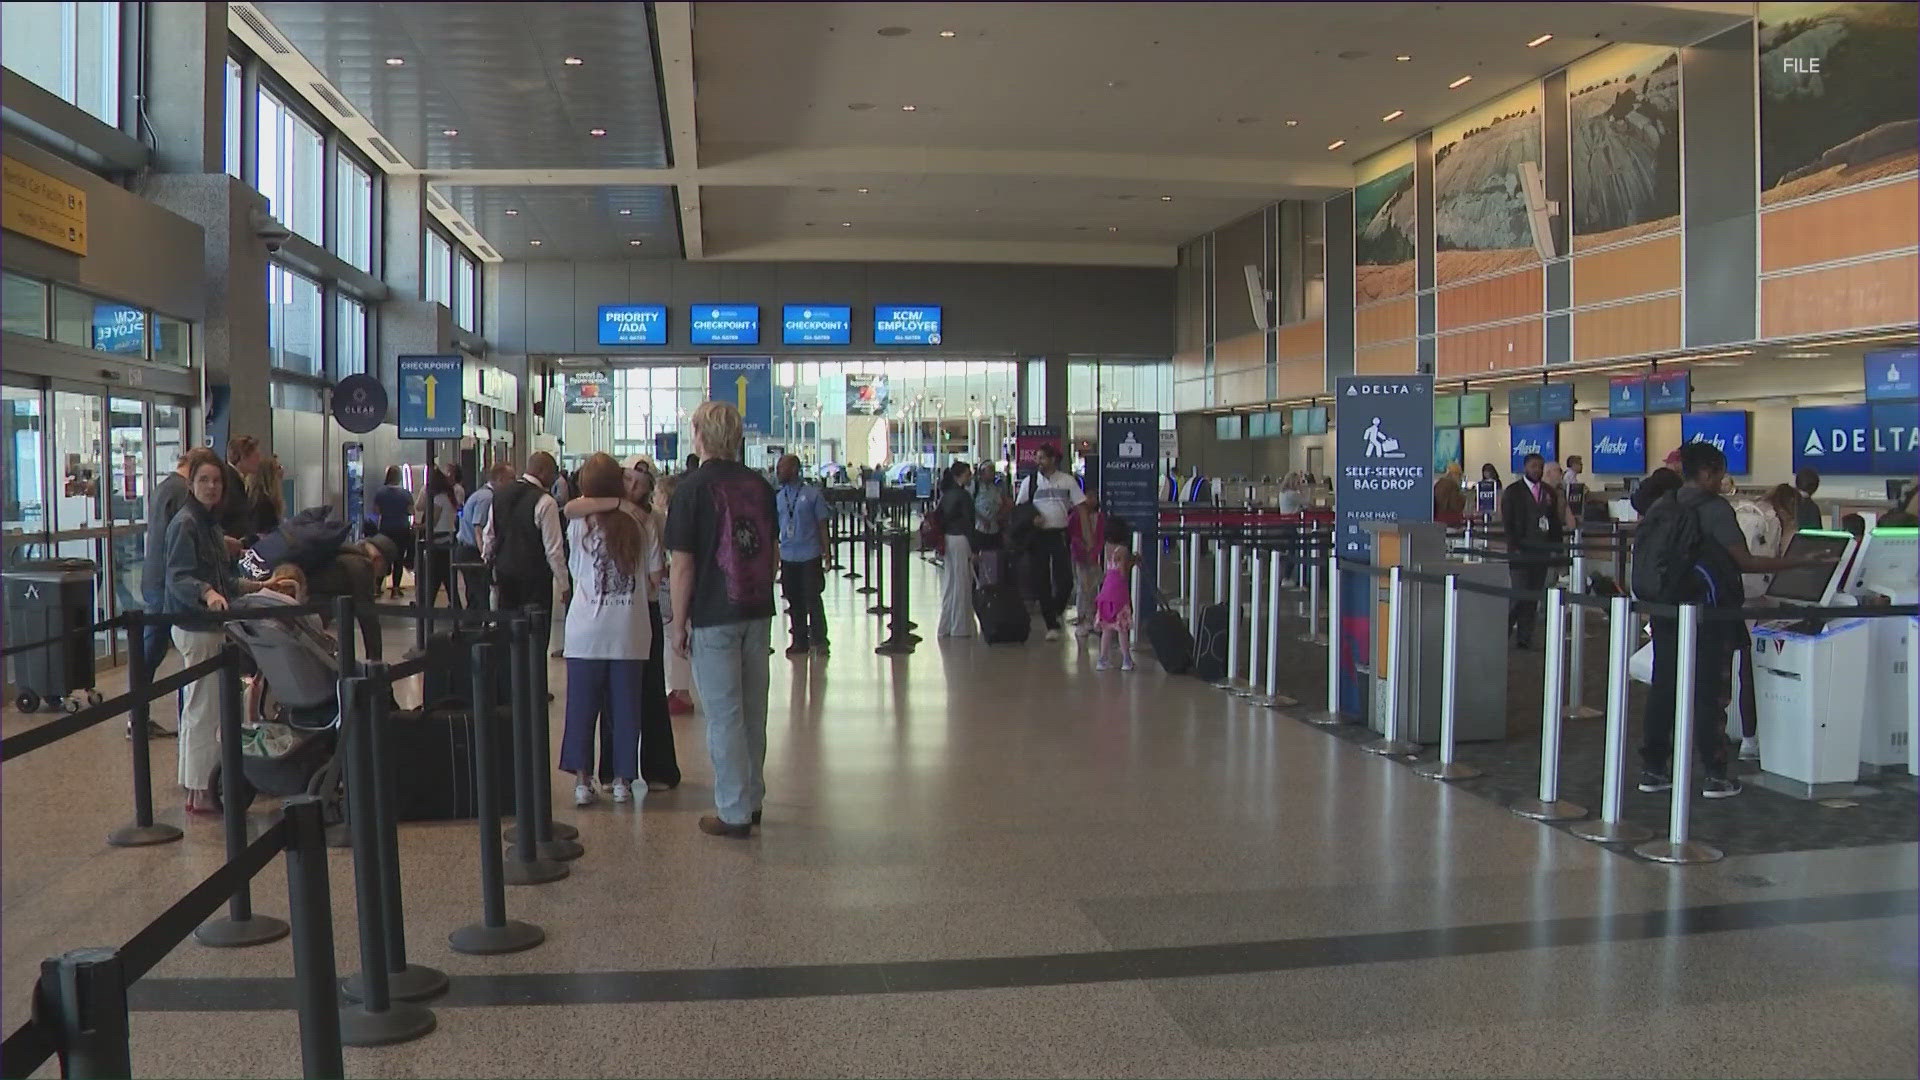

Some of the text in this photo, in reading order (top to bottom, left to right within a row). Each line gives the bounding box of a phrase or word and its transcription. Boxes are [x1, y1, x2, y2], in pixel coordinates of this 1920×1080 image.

[605, 311, 659, 323] PRIORITY
[893, 310, 923, 321] KCM/
[618, 323, 647, 332] /ADA
[693, 321, 757, 331] CHECKPOINT 1
[785, 321, 849, 331] CHECKPOINT 1
[877, 321, 938, 332] EMPLOYEE
[401, 362, 461, 370] CHECKPOINT 1
[712, 363, 765, 371] CHECKPOINT
[1361, 384, 1409, 394] DELTA
[344, 406, 375, 414] CLEAR
[1593, 434, 1628, 456] Alaska
[1832, 427, 1918, 453] DELTA
[1513, 438, 1541, 457] Alaska
[1105, 462, 1155, 470] AGENT ASSIST
[1345, 466, 1424, 478] SELF-SERVICE
[1353, 478, 1415, 490] BAG DROP
[1347, 511, 1399, 520] PLEASE HAVE:
